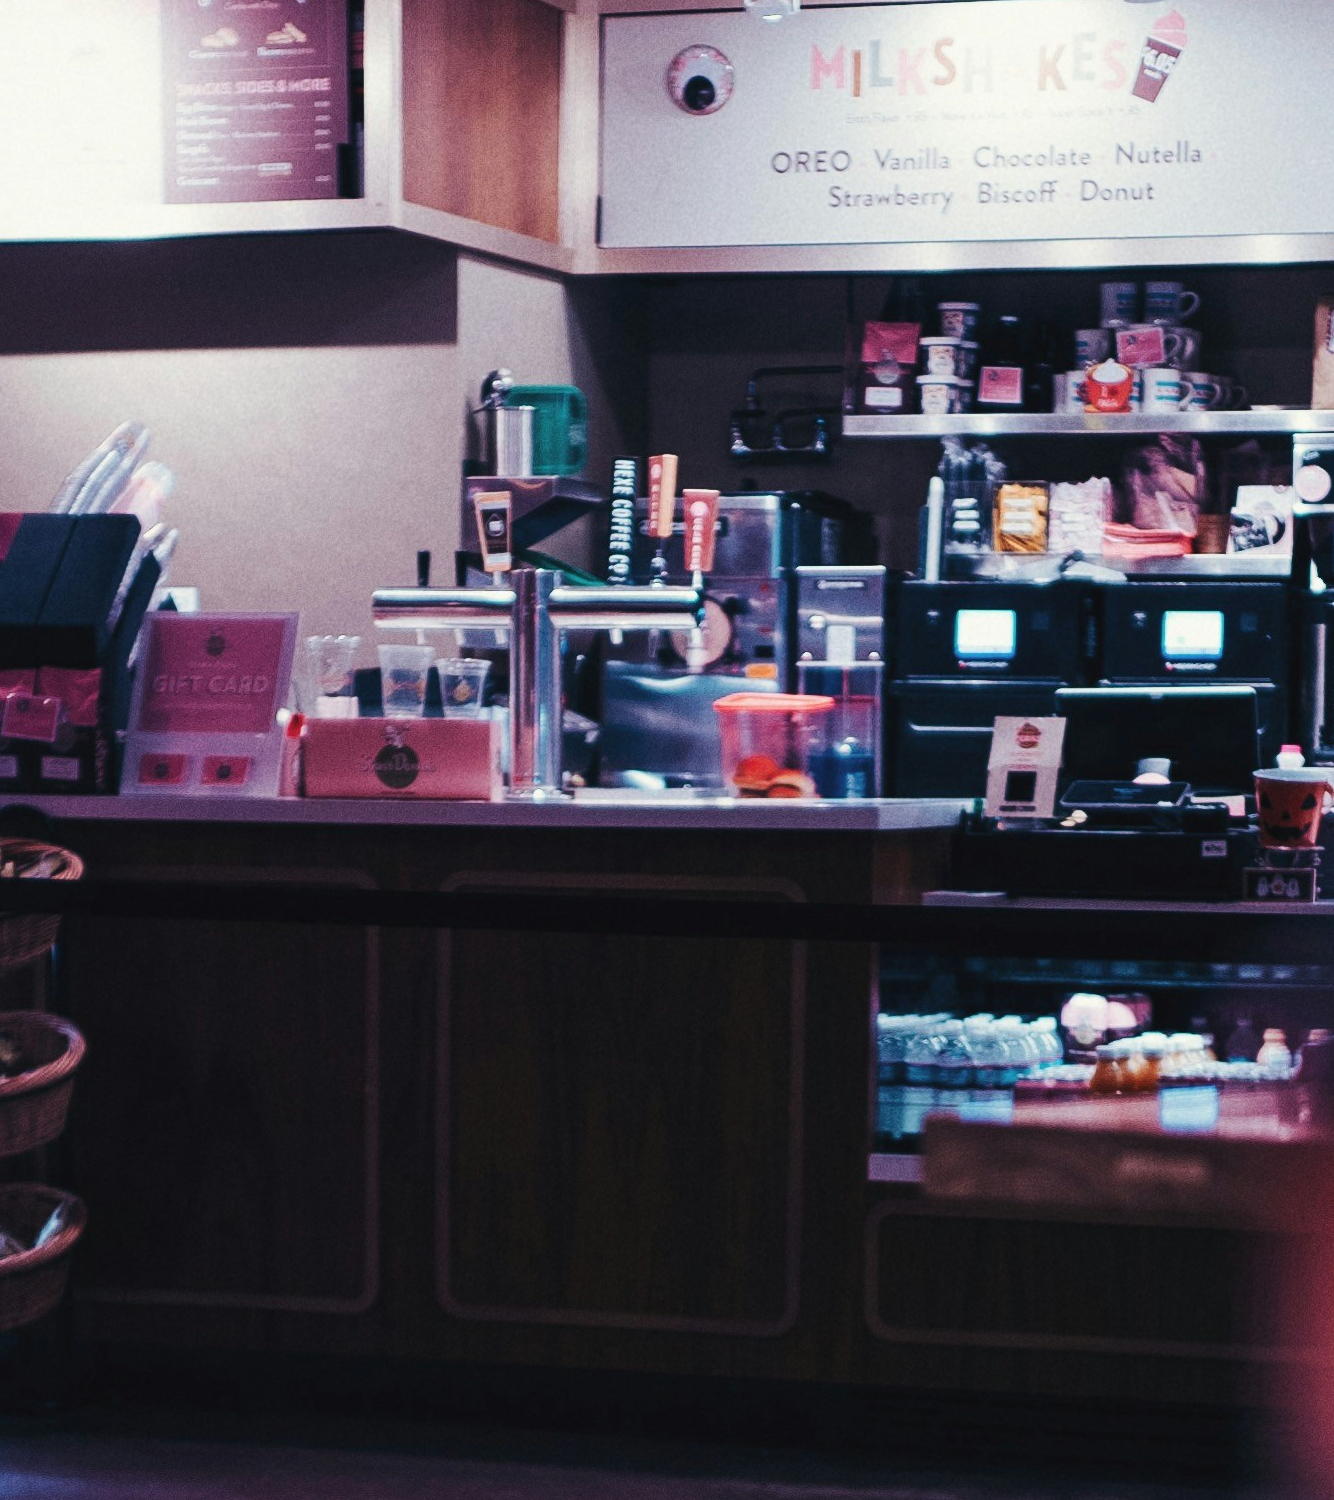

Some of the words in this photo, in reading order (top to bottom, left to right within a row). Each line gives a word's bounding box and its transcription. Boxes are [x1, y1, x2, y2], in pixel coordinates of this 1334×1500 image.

[809, 31, 1129, 98] MILKSHKES
[770, 149, 852, 173] OREO
[873, 147, 951, 171] Vanilla
[972, 144, 1092, 169] Chocolate
[1114, 140, 1203, 165] Nutella
[828, 185, 955, 211] Strawberry
[977, 179, 1059, 205] Biscoff
[1080, 179, 1156, 203] Donut
[612, 459, 636, 496] HEXE
[609, 499, 633, 551] COFFEE
[155, 674, 204, 694] GIFT
[208, 674, 268, 694] CARD
